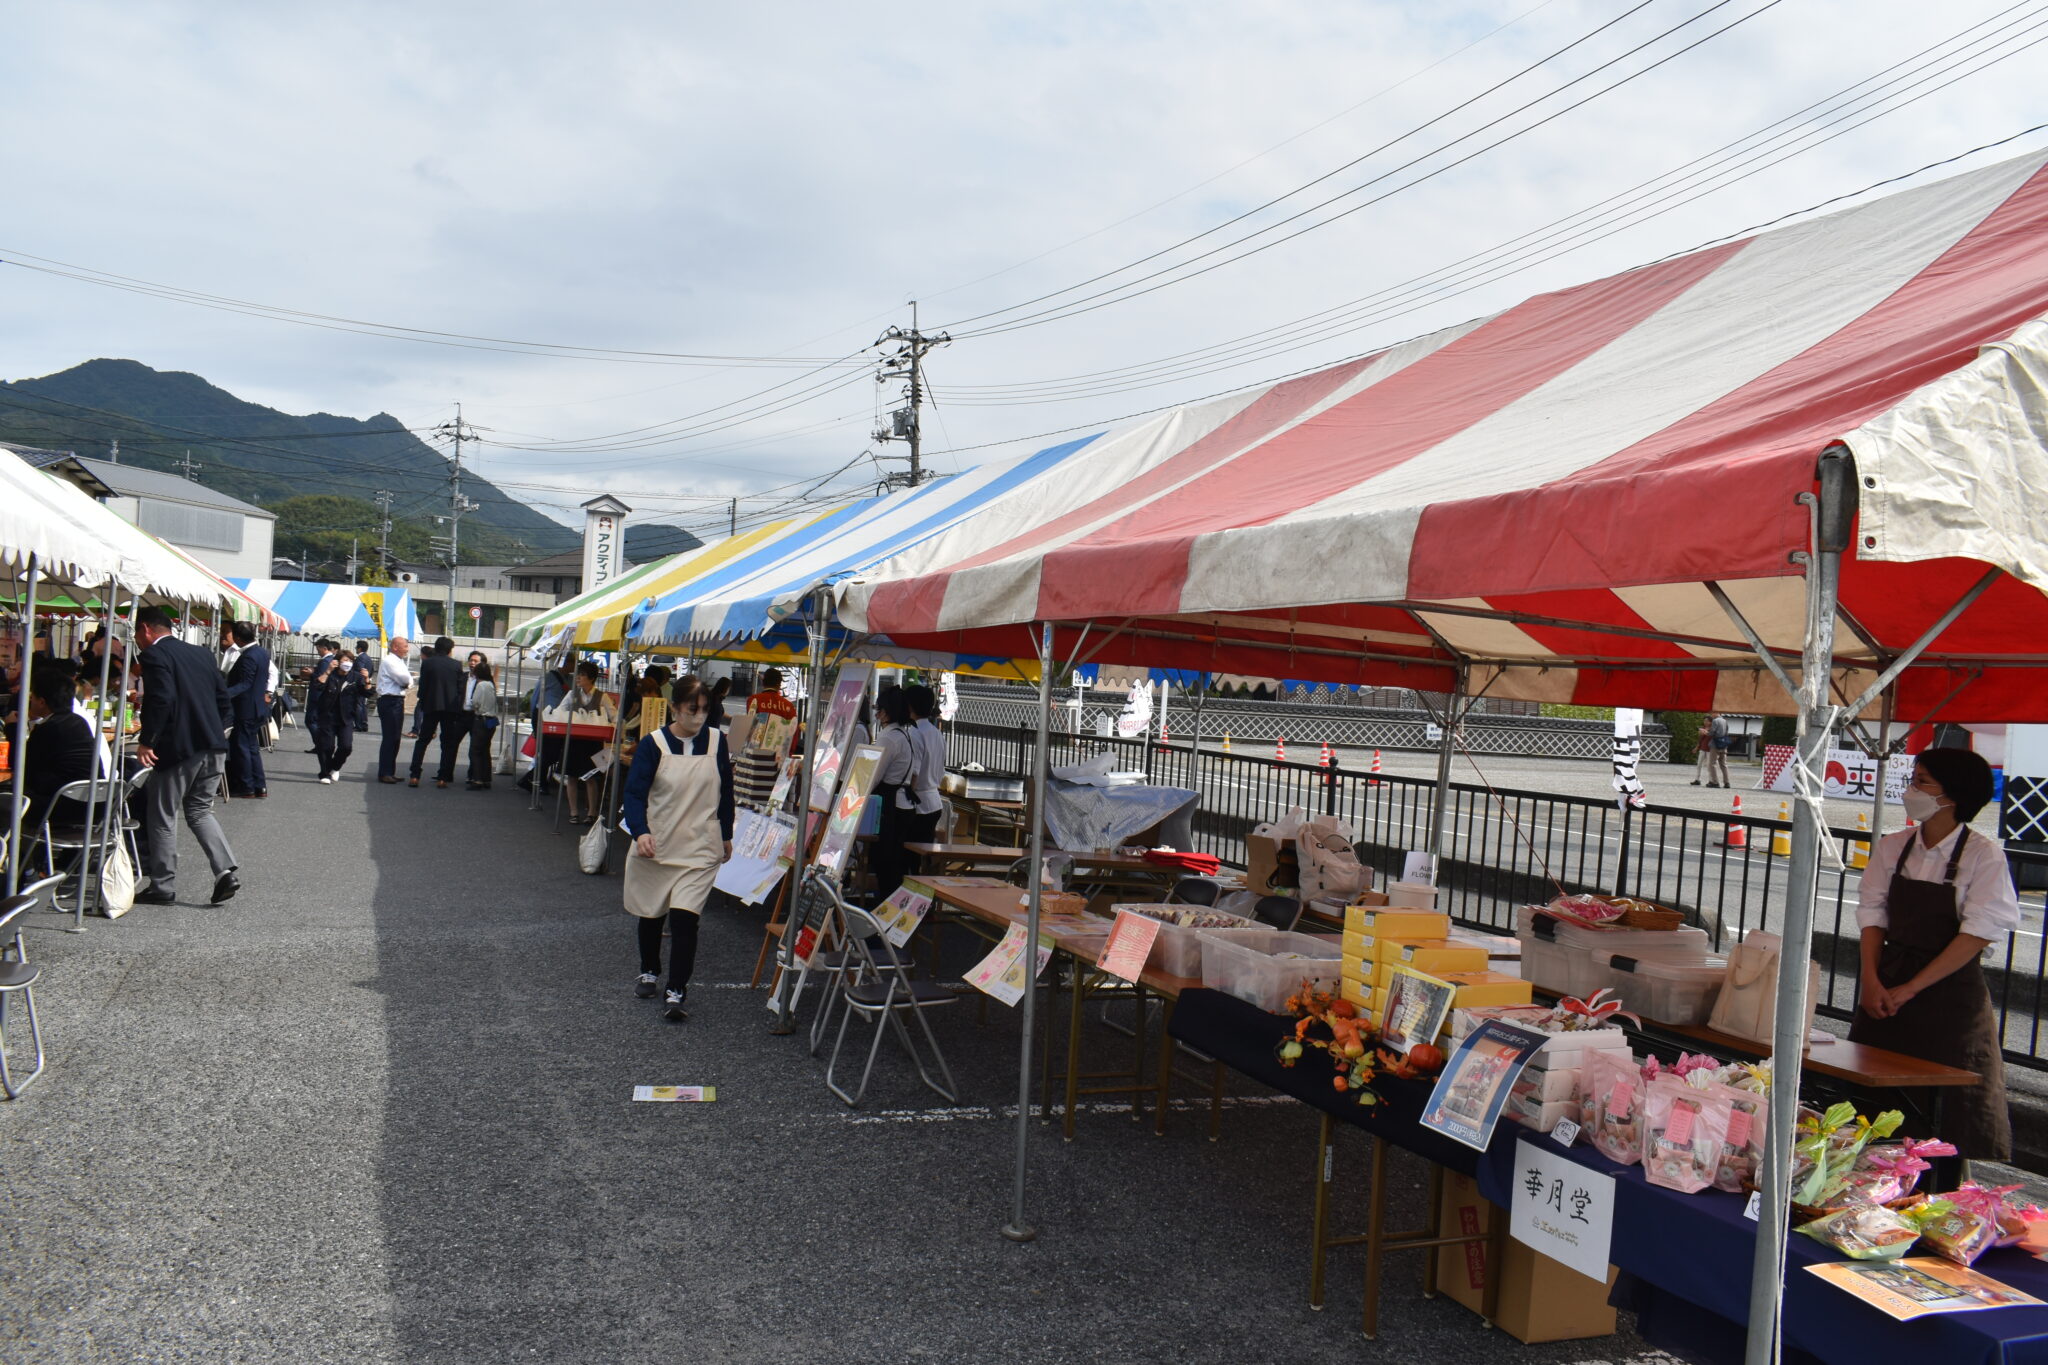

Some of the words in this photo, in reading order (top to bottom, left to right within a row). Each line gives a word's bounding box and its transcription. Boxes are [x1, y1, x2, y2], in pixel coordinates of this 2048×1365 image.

[760, 699, 791, 712] adelie
[1847, 763, 1875, 796] 来
[1524, 1168, 1592, 1225] 華月堂
